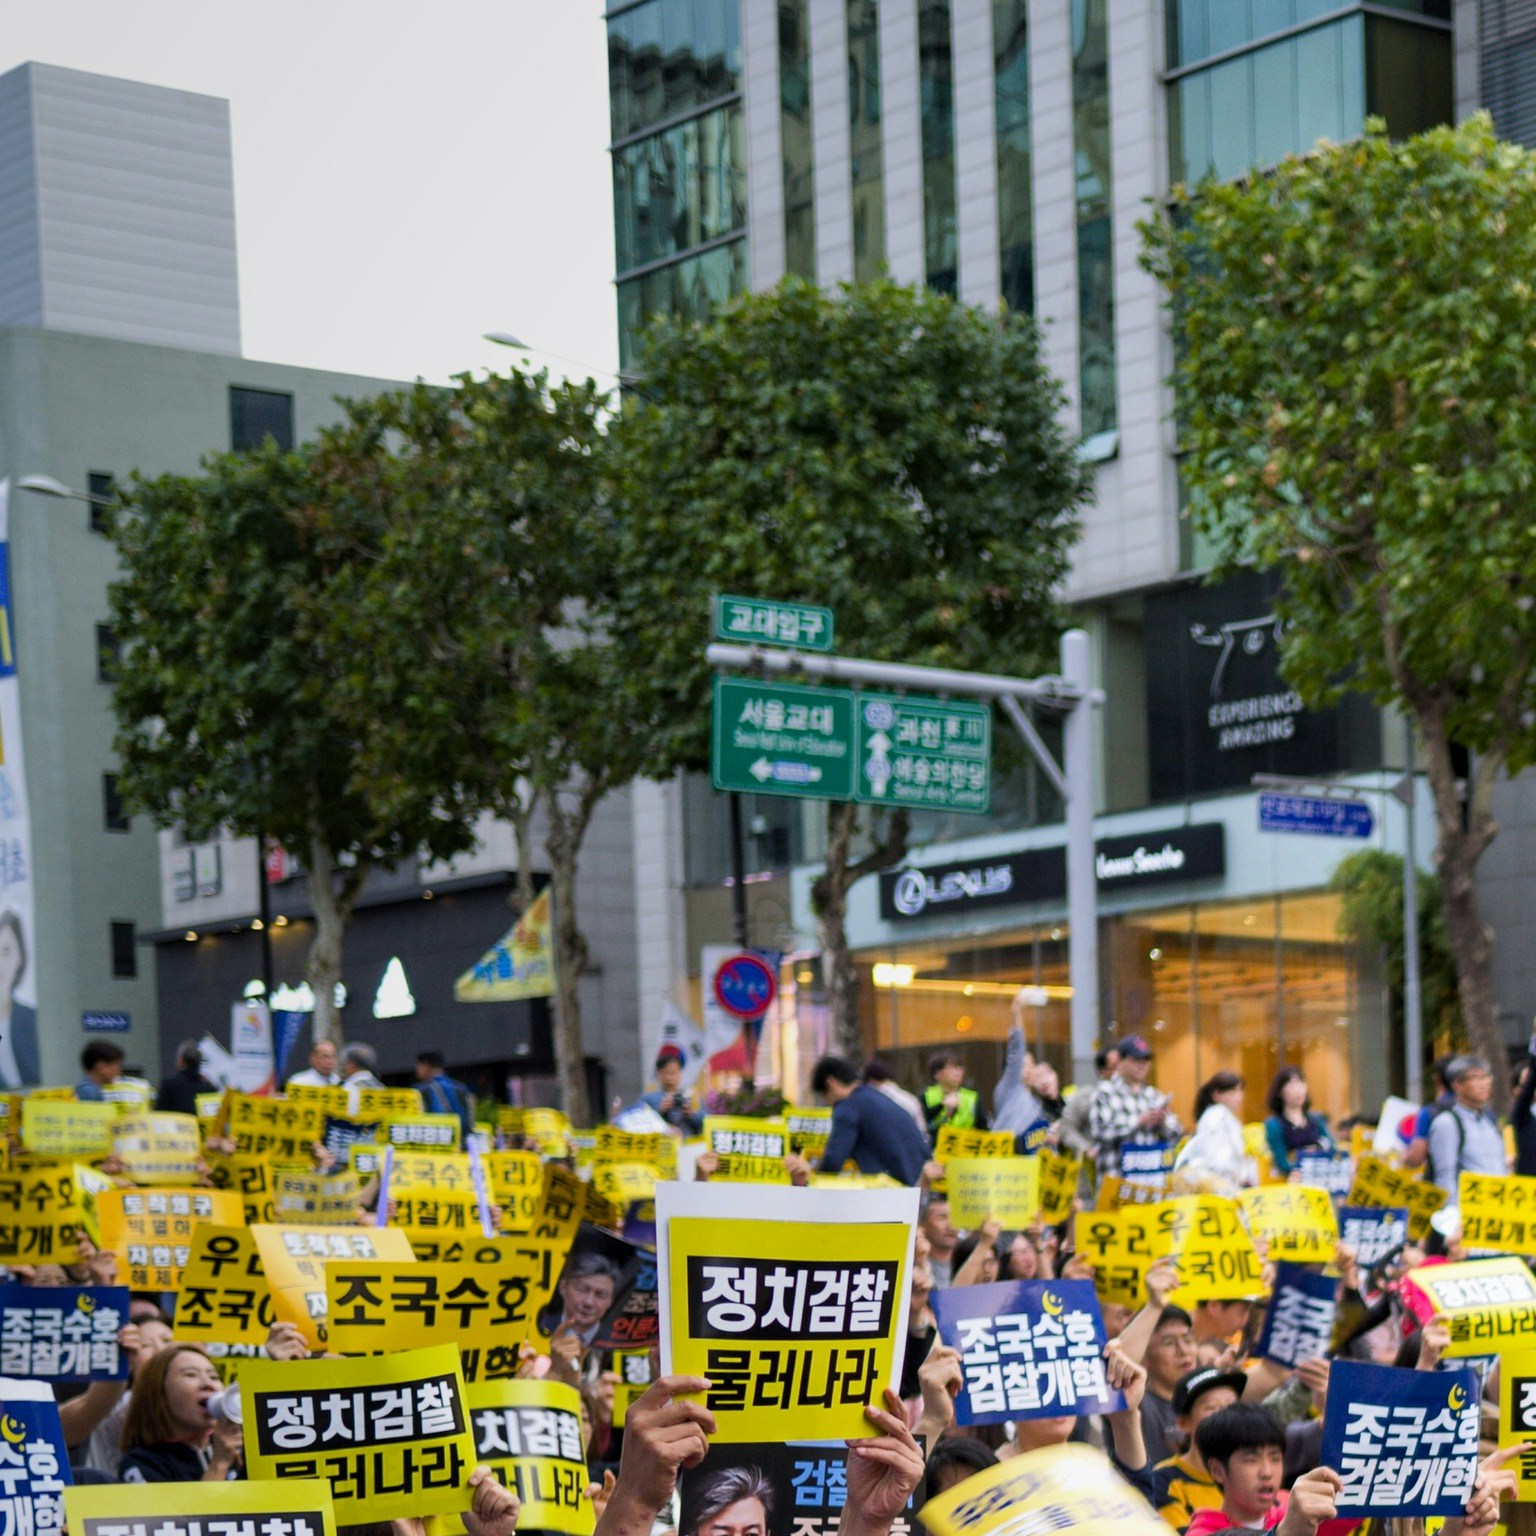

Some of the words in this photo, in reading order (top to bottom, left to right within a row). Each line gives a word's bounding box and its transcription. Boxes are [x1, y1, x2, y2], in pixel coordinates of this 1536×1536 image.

[728, 605, 825, 644] 교대입구
[738, 697, 836, 736] 서울교대
[1219, 716, 1296, 751] AMAZING
[926, 864, 1013, 902] LEXUS
[712, 1131, 784, 1157] 정치검찰
[2, 1305, 120, 1342] 조국수호
[333, 1274, 531, 1329] 조국수호
[700, 1264, 890, 1333] 정치검찰
[1, 1340, 119, 1376] 검찰개혁
[954, 1308, 1100, 1365] 조국수호
[703, 1346, 877, 1413] 물러나라
[965, 1355, 1109, 1414] 검찰개혁
[266, 1380, 457, 1449] 정치검찰
[1344, 1402, 1480, 1457] 조국수호
[1340, 1450, 1478, 1507] 검찰개혁
